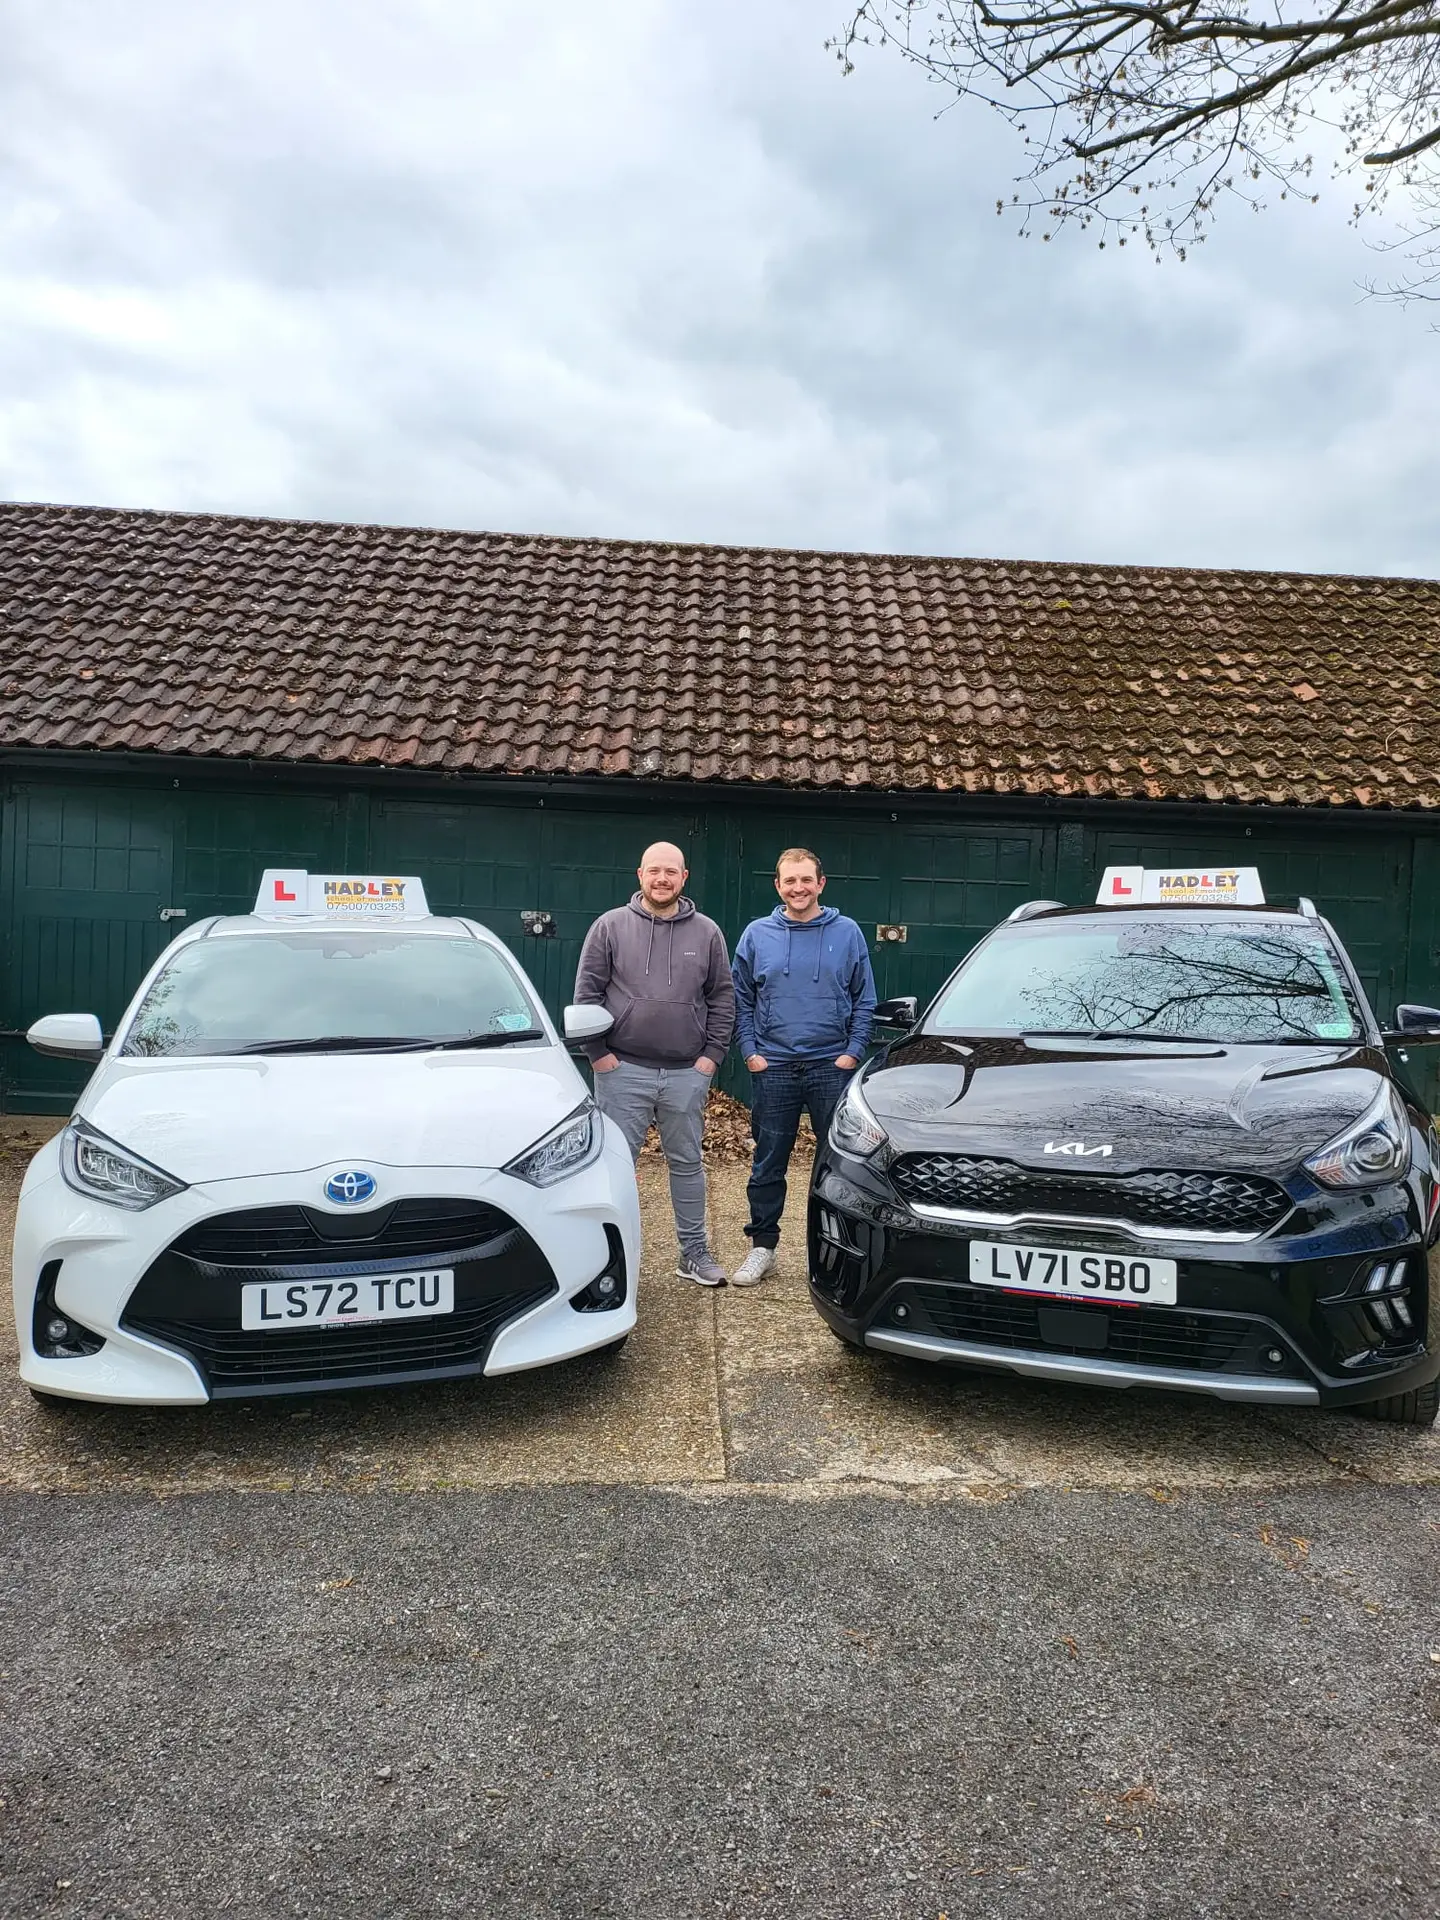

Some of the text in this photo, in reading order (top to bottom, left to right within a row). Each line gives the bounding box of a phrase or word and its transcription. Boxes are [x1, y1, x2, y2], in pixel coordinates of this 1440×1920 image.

[173, 779, 180, 788] 3
[1245, 827, 1252, 836] 6
[324, 881, 406, 896] HADLEY
[1112, 877, 1132, 895] L
[1158, 875, 1240, 888] HADLEY
[274, 880, 296, 901] L
[326, 902, 405, 911] 07500703253
[1043, 1141, 1113, 1157] KIA
[992, 1248, 1150, 1294] LV71 SBO
[260, 1275, 440, 1320] LS72 TCU
